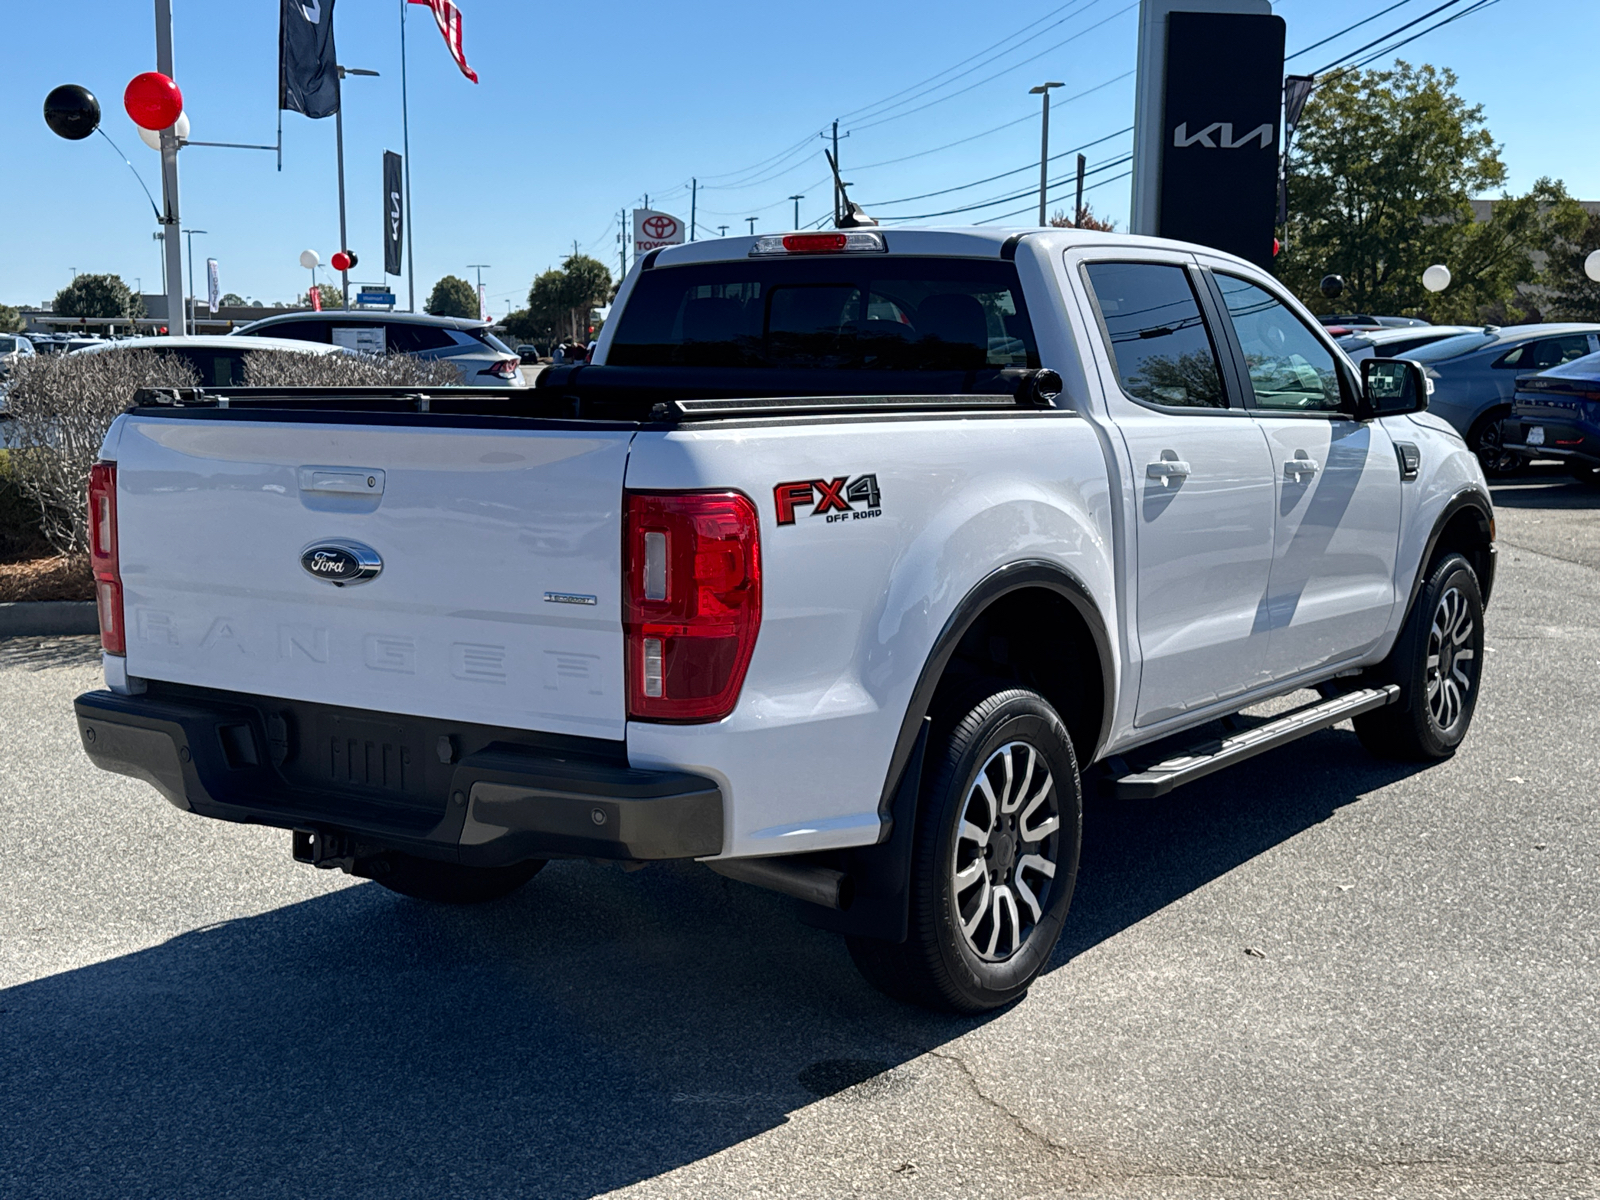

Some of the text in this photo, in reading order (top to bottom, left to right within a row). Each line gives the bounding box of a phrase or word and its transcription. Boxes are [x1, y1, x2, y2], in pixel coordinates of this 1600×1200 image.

[1174, 122, 1273, 149] KIA
[773, 473, 882, 528] FX4
[826, 509, 882, 523] OFF ROAD
[311, 551, 345, 573] Ford
[136, 606, 603, 696] RANGER
